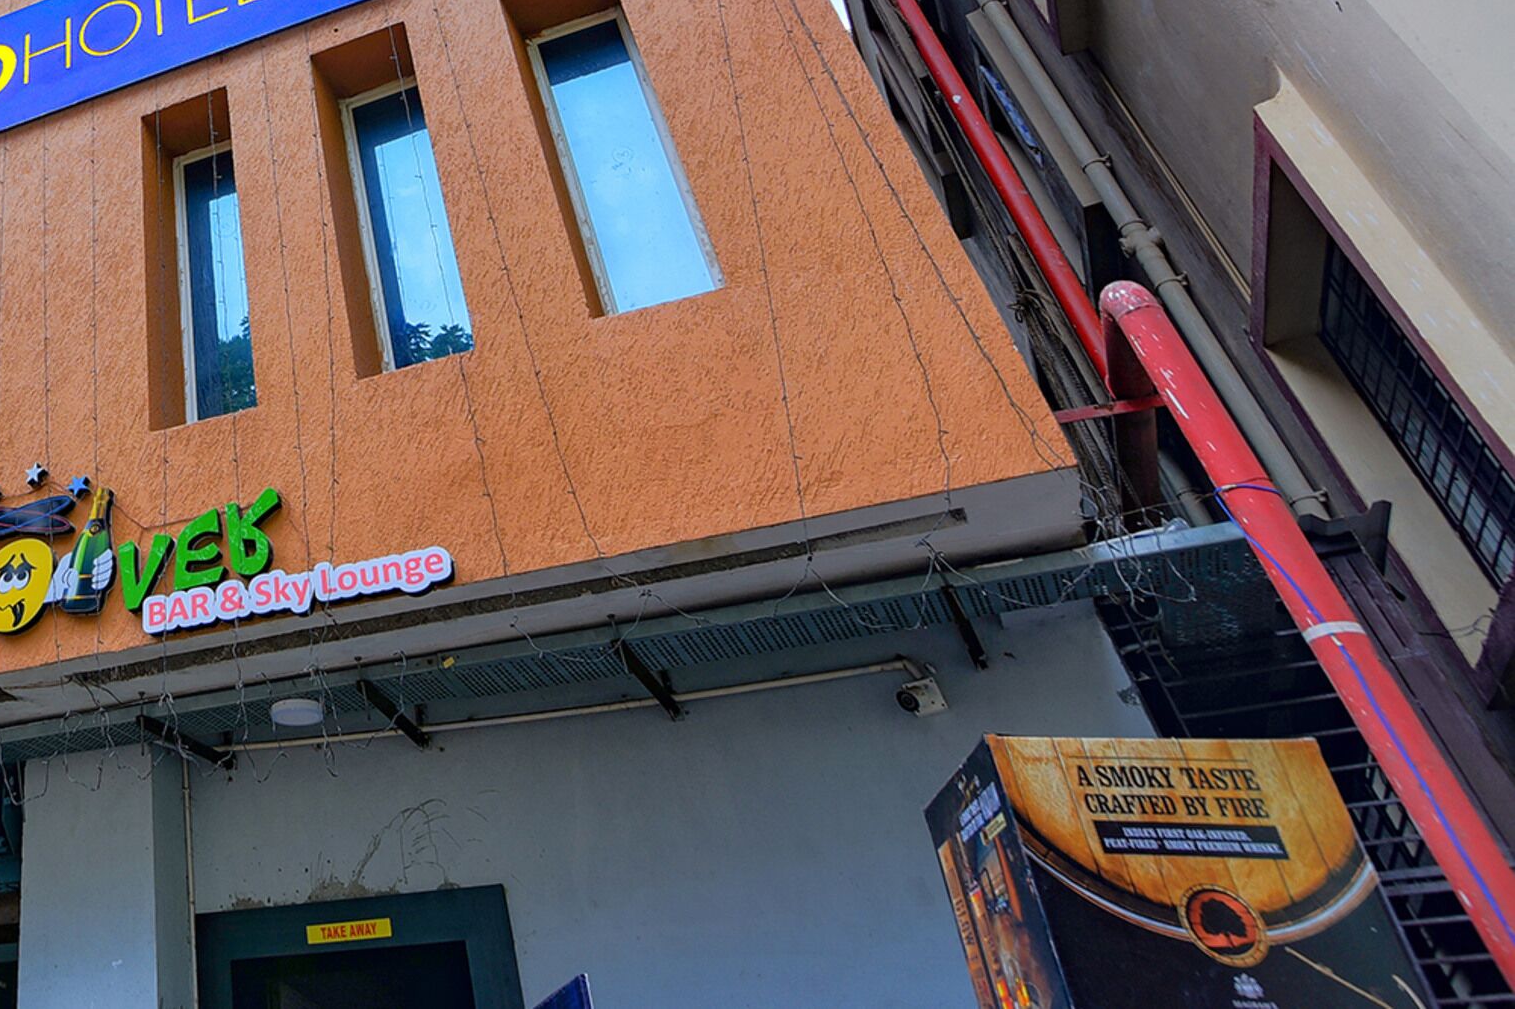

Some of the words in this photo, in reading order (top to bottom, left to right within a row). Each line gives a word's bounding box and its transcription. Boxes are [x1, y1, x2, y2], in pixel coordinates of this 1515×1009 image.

[147, 589, 216, 627] BAR
[219, 586, 242, 611] &
[255, 574, 311, 612] Sky
[319, 550, 444, 598] Lounge
[1077, 765, 1093, 787] A
[1095, 765, 1174, 789] SMOKY
[1179, 766, 1261, 791] TASTE
[1085, 793, 1177, 816] CRAFTED
[1181, 796, 1211, 817] BY
[1215, 797, 1270, 819] FIRE
[320, 925, 347, 940] TAKE
[350, 922, 377, 938] AWAY
